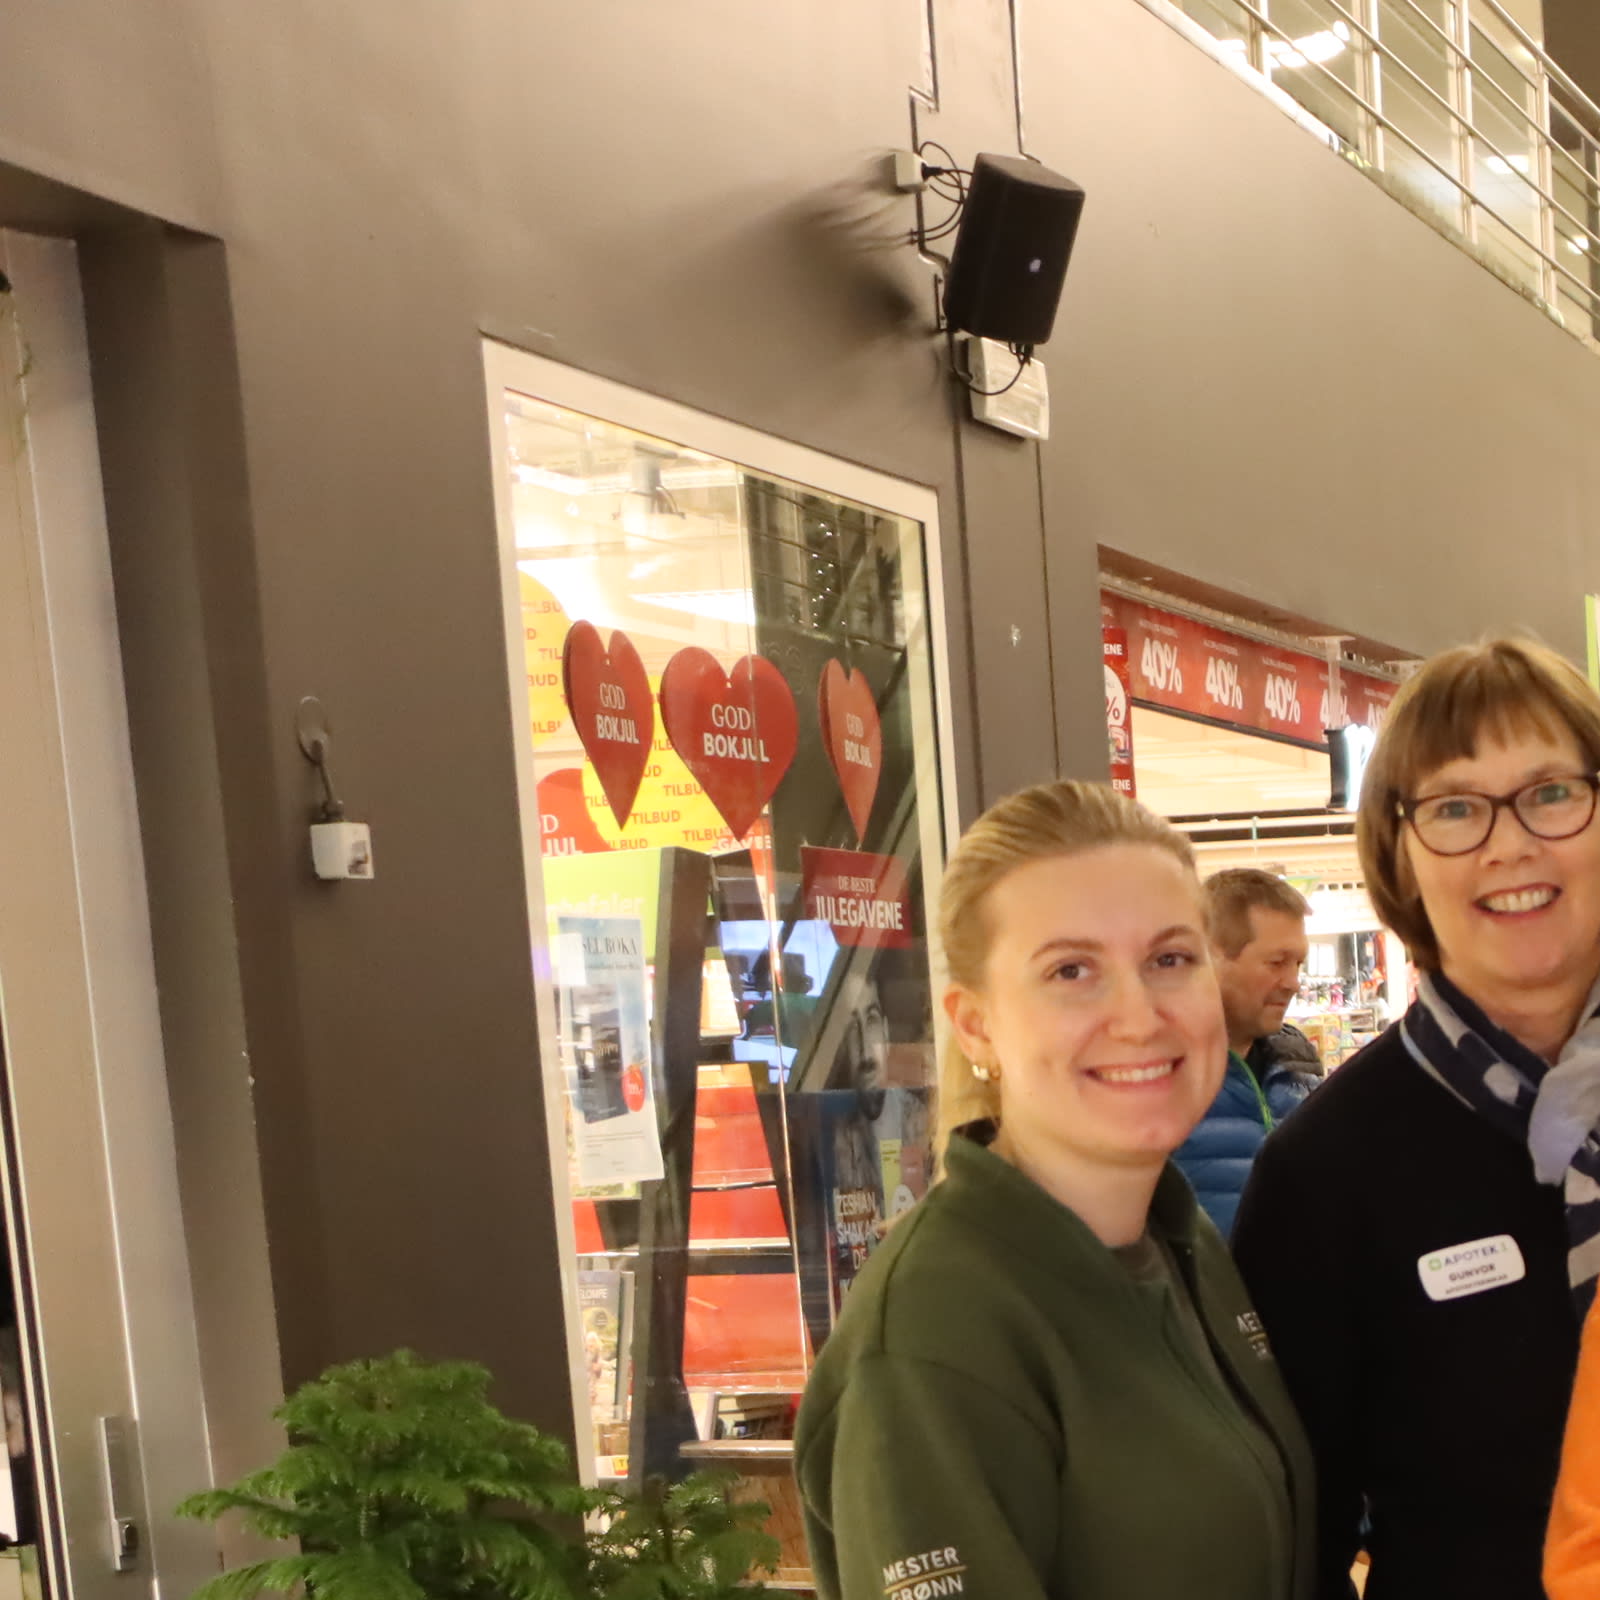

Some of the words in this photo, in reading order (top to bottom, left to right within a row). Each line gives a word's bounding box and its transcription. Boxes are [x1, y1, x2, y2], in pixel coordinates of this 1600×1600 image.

[538, 648, 565, 660] TIL
[1141, 637, 1183, 694] 40%
[527, 673, 558, 686] BUD
[1205, 656, 1243, 710] 40%
[600, 683, 625, 710] GOD
[1264, 673, 1301, 724] 40%
[596, 714, 640, 745] BOKJUL
[712, 703, 751, 730] GOD
[846, 713, 864, 738] GOD
[703, 732, 770, 762] BOKJUL
[844, 740, 873, 768] BOKJUL
[663, 784, 704, 796] TILBU
[631, 810, 680, 825] TILBUD
[543, 836, 583, 857] JUL
[682, 828, 725, 842] TILBU
[838, 875, 849, 890] DE
[814, 895, 903, 930] JULEGAVENE
[1444, 1246, 1498, 1266] APOTEK
[882, 1546, 960, 1586] MESTER
